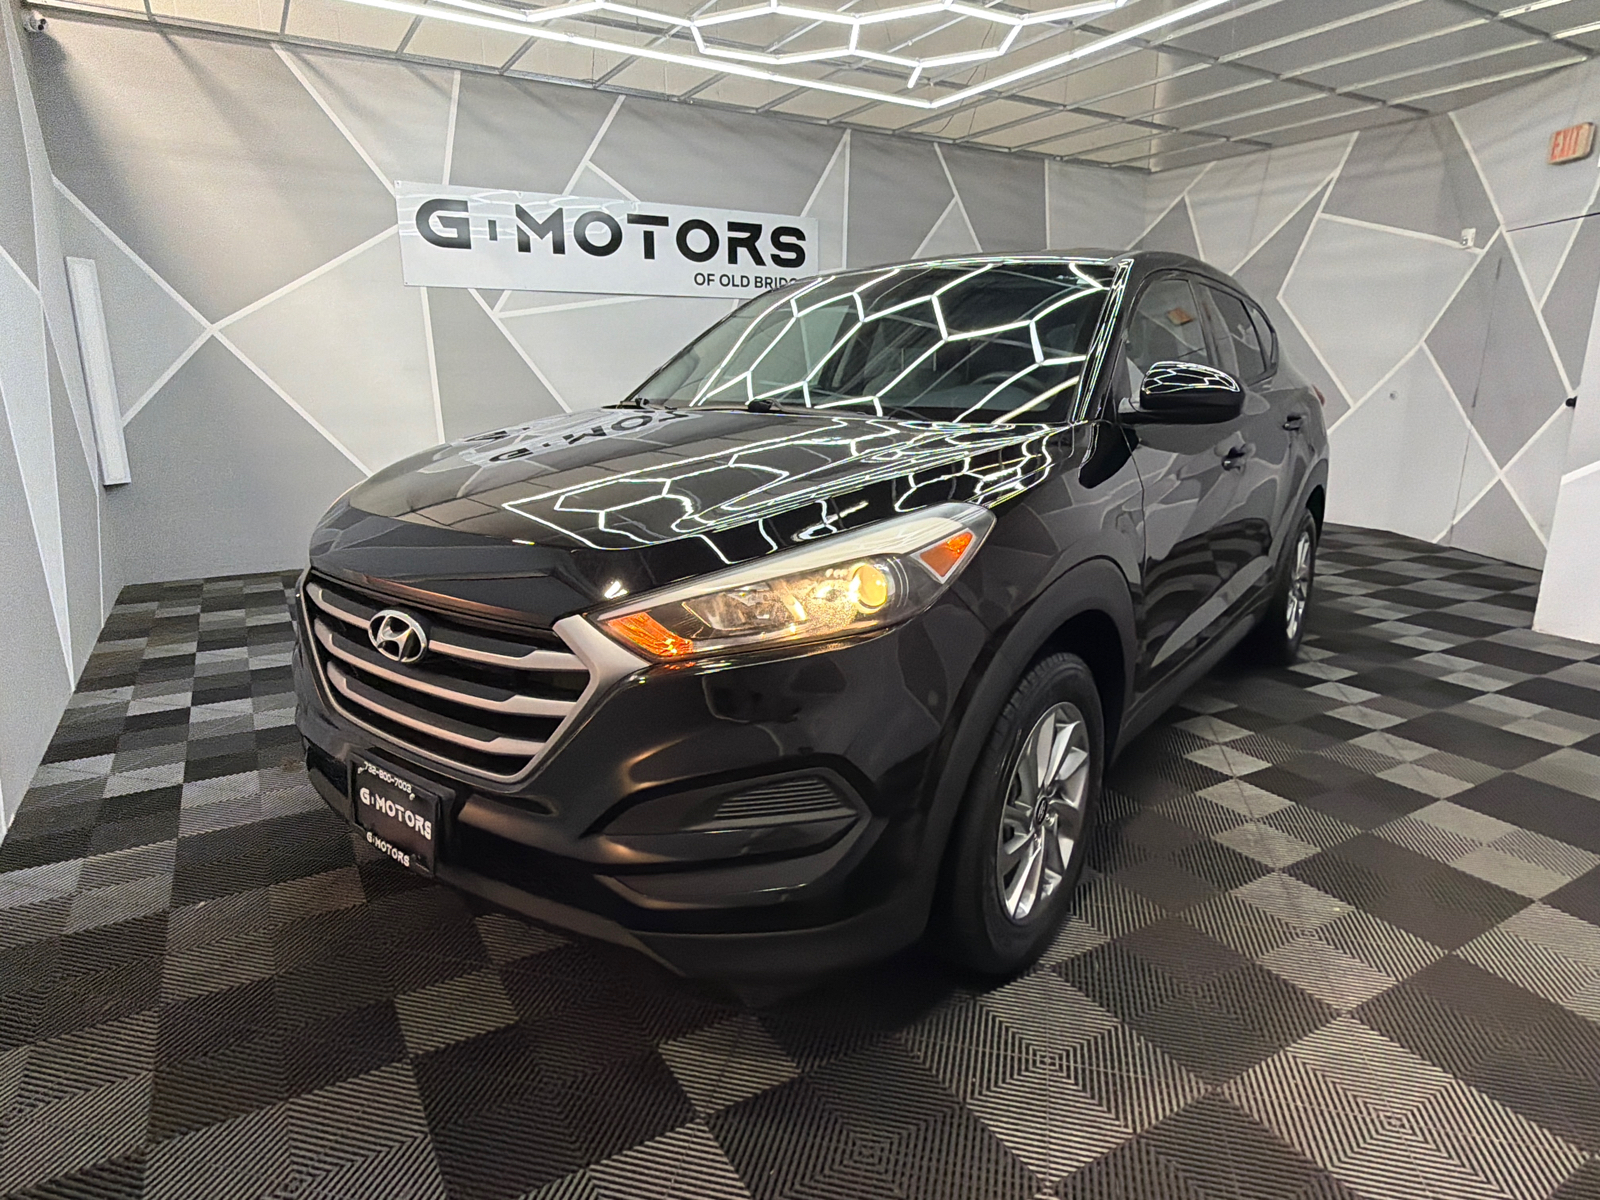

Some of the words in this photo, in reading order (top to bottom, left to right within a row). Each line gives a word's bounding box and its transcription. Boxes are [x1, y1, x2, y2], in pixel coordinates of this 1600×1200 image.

[694, 272, 715, 286] OF
[719, 273, 750, 287] OLD
[754, 275, 797, 291] BRID
